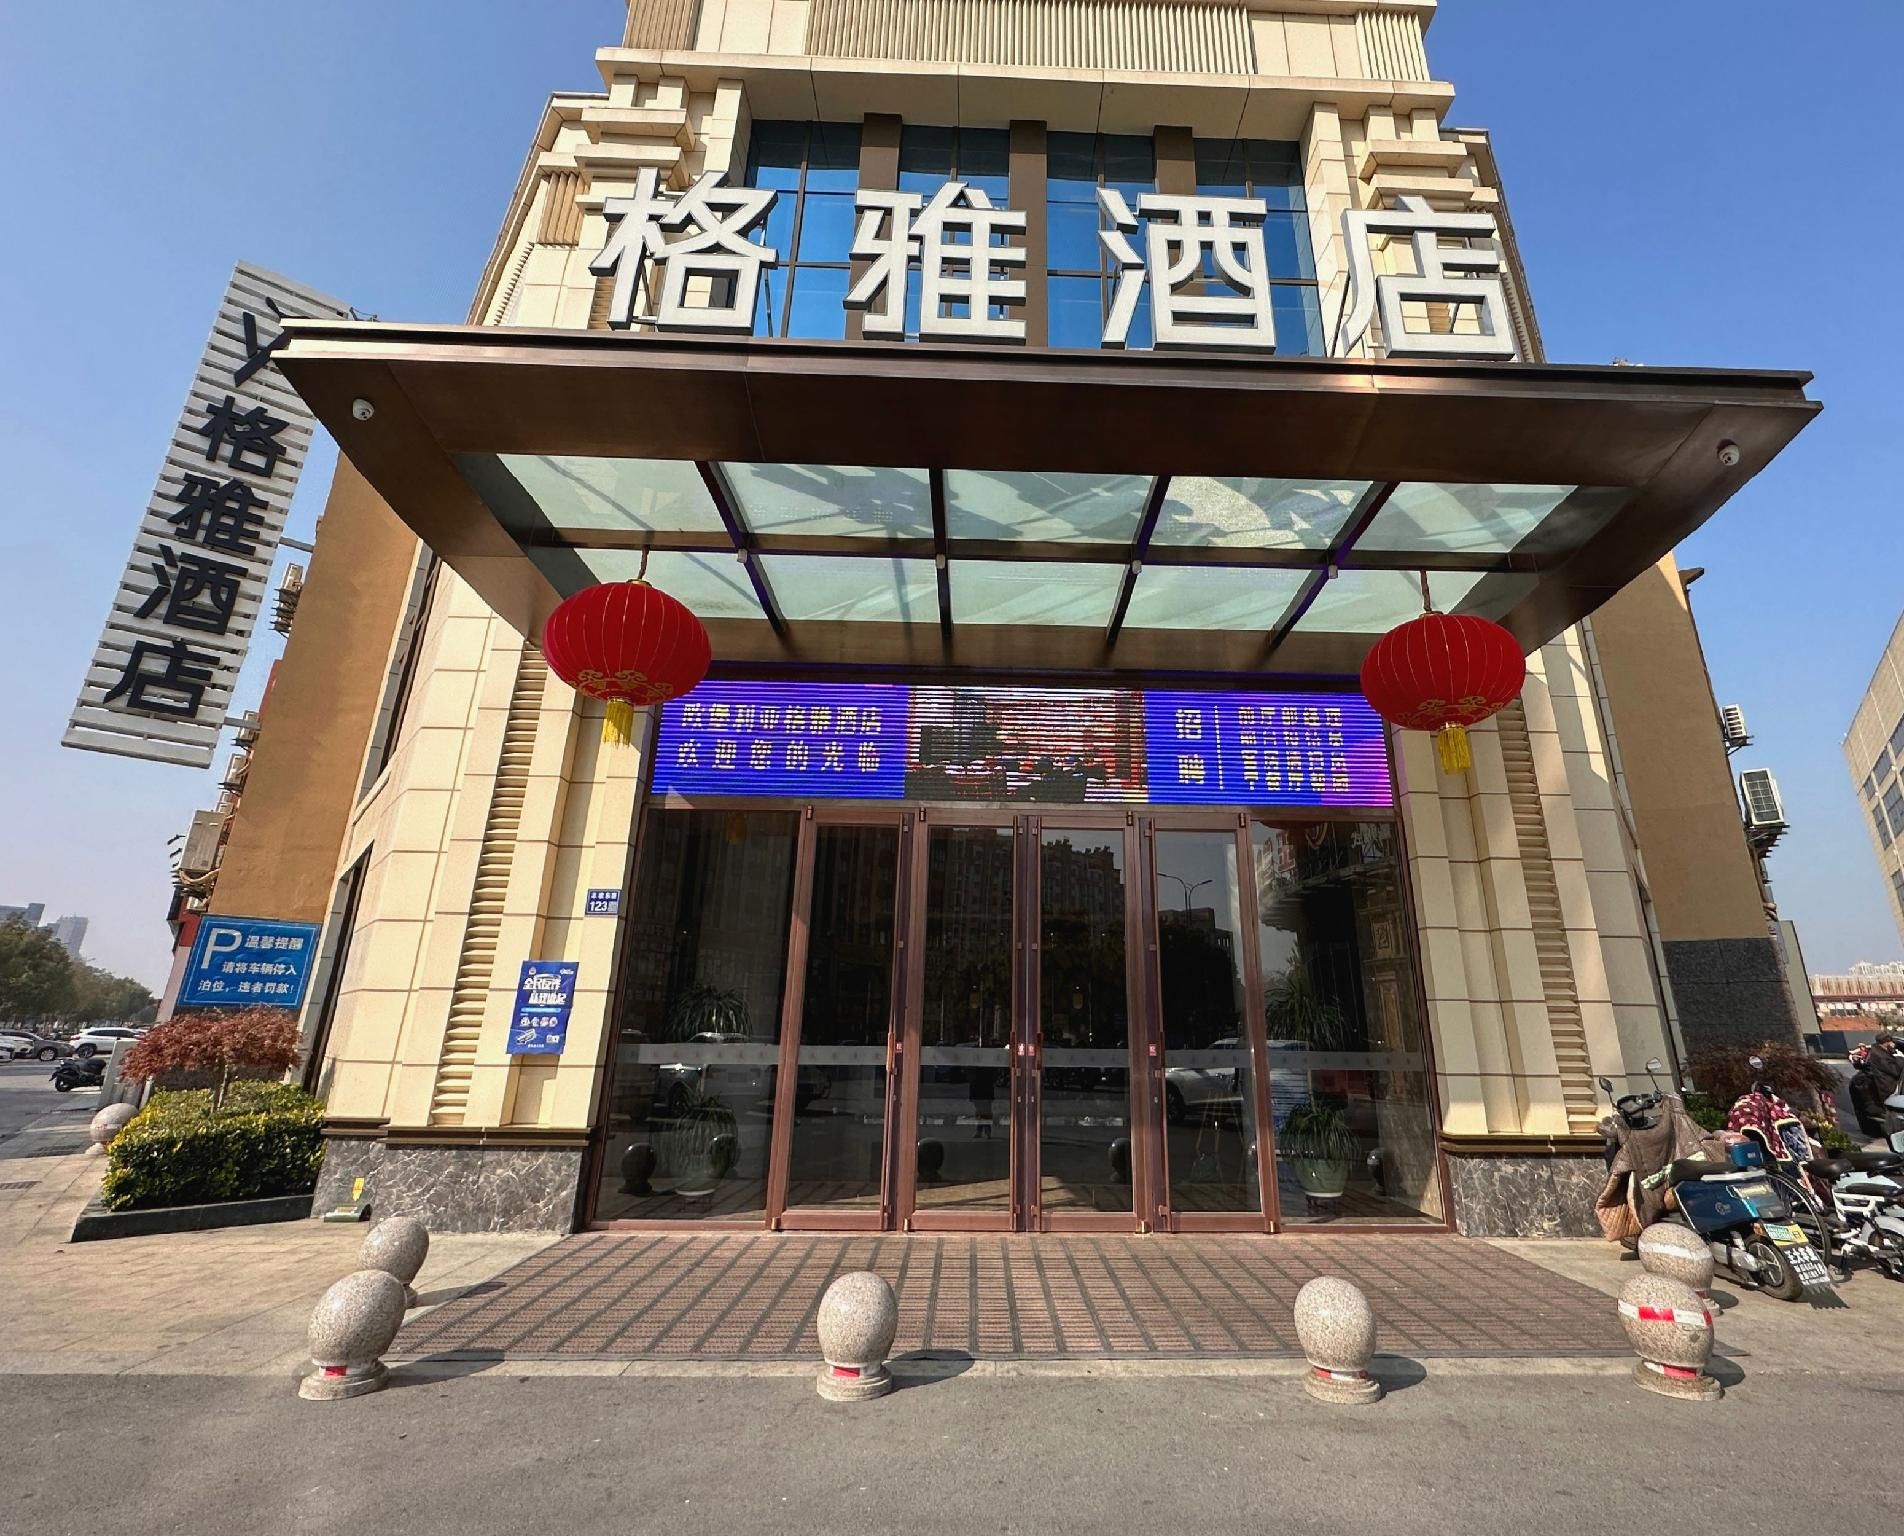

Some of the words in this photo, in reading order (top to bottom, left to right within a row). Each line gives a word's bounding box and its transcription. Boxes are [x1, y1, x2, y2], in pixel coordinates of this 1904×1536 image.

[589, 167, 1516, 361] 格雅酒店
[103, 395, 290, 718] 格雅酒店
[676, 738, 881, 772] 欢迎您的光临
[590, 900, 608, 912] 123
[244, 934, 304, 951] 温馨提醒
[221, 961, 298, 976] 请将车辆停入
